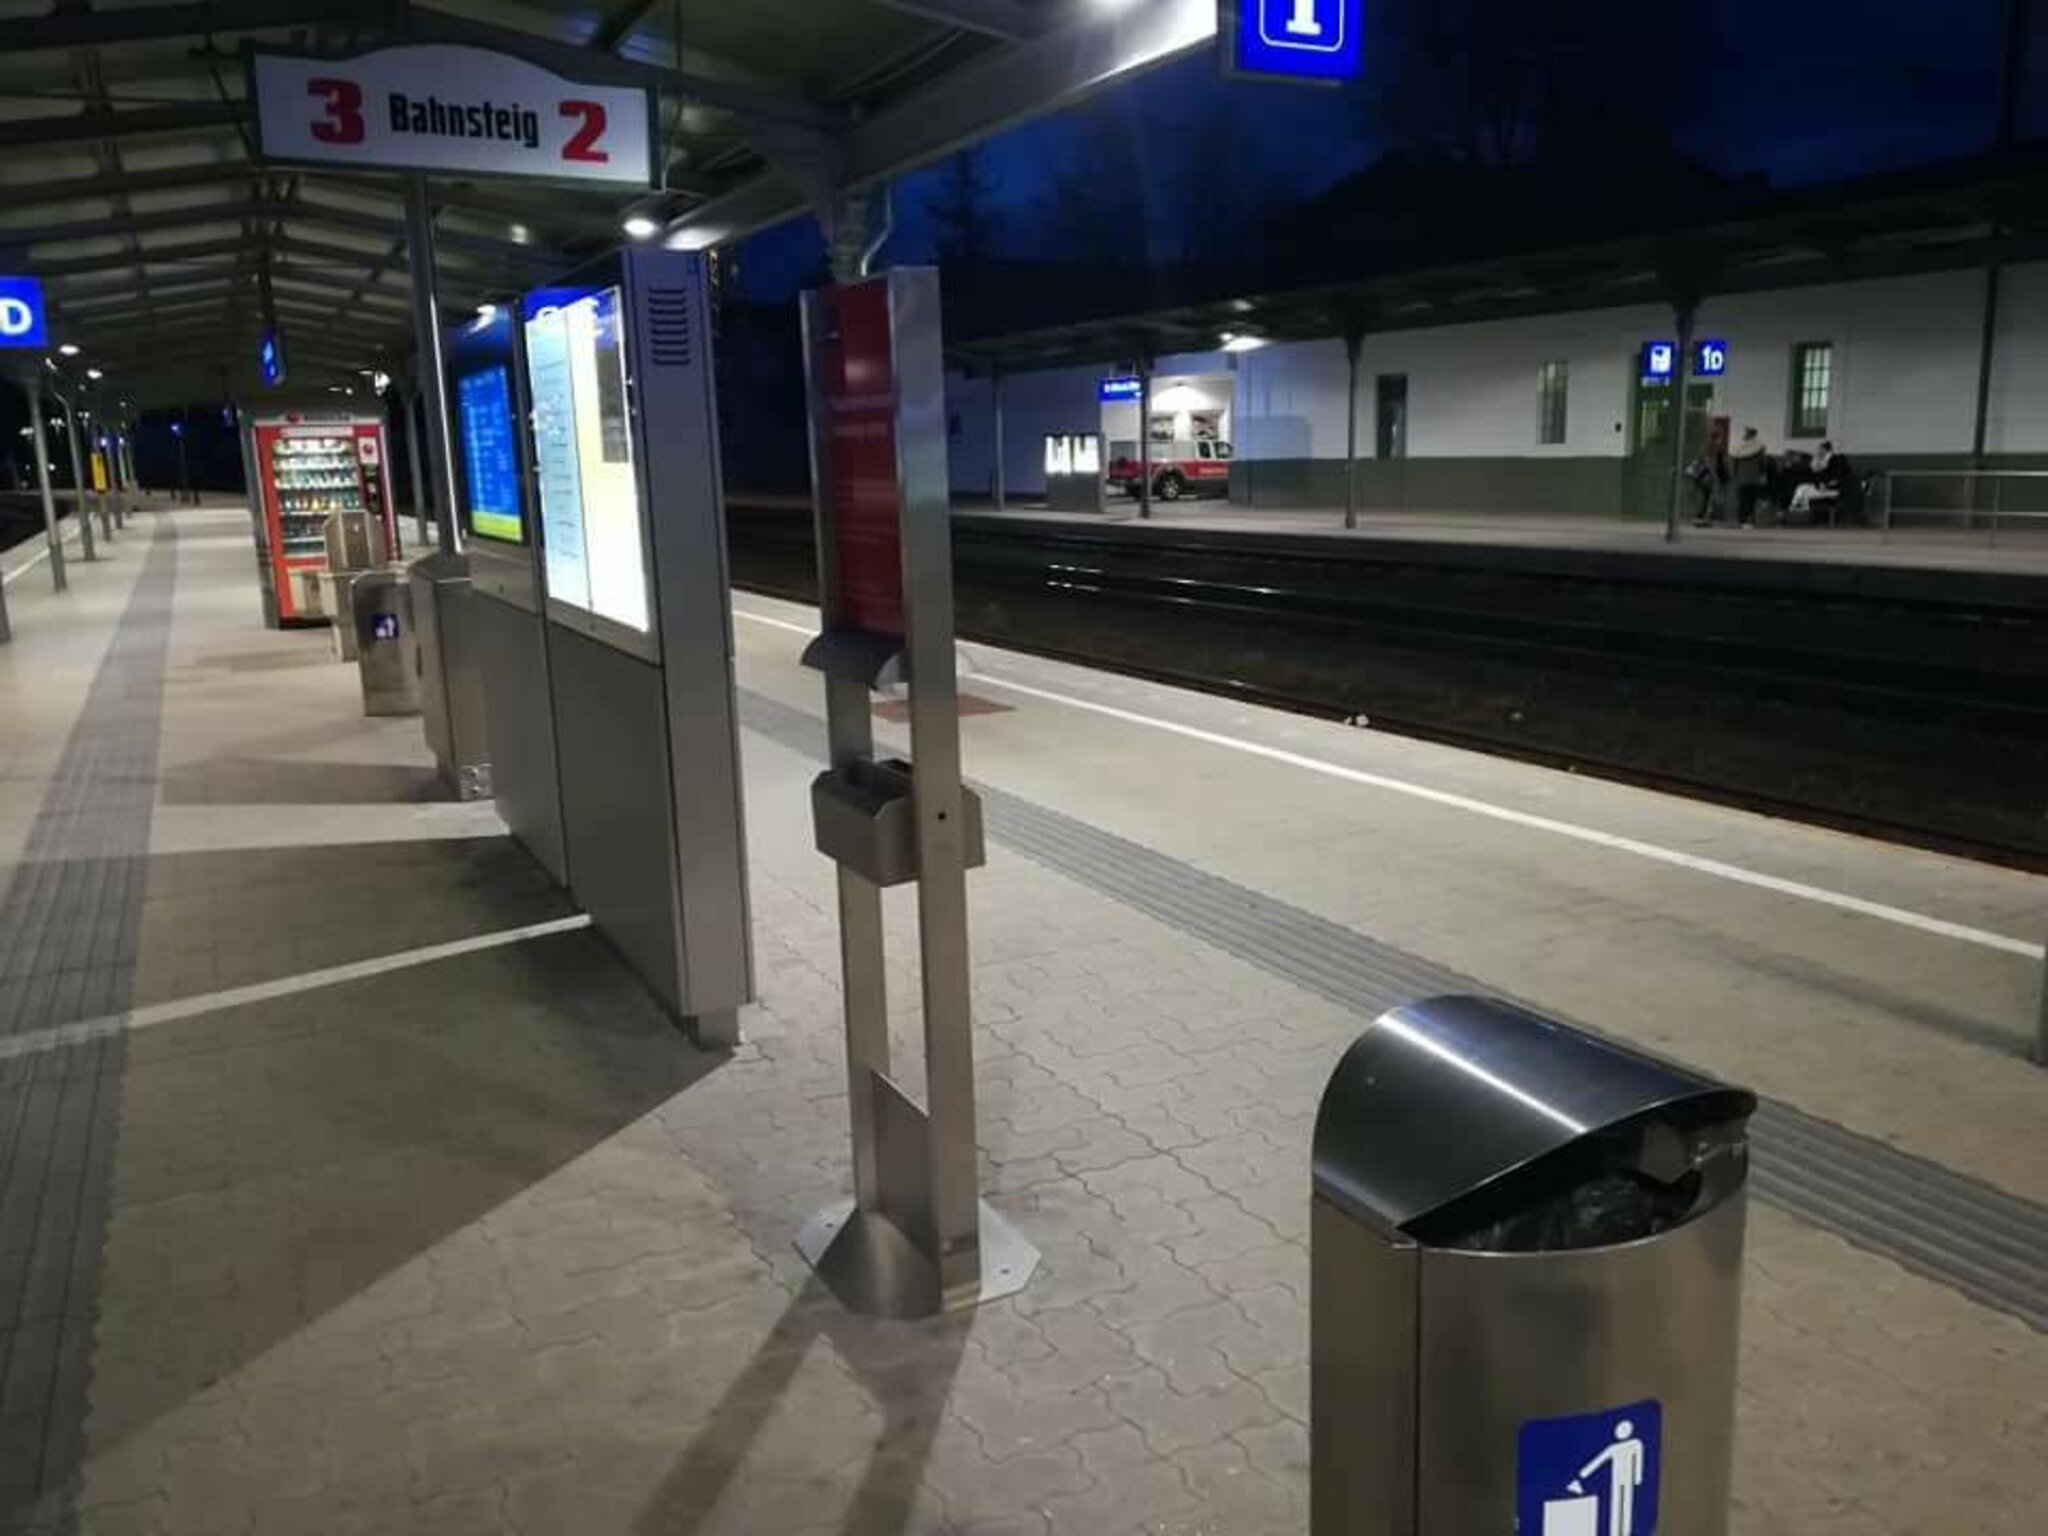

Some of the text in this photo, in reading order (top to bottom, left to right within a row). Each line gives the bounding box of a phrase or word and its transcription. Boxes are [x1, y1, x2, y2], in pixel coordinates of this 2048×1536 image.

[307, 78, 610, 163] 3 Bahnsteig 2
